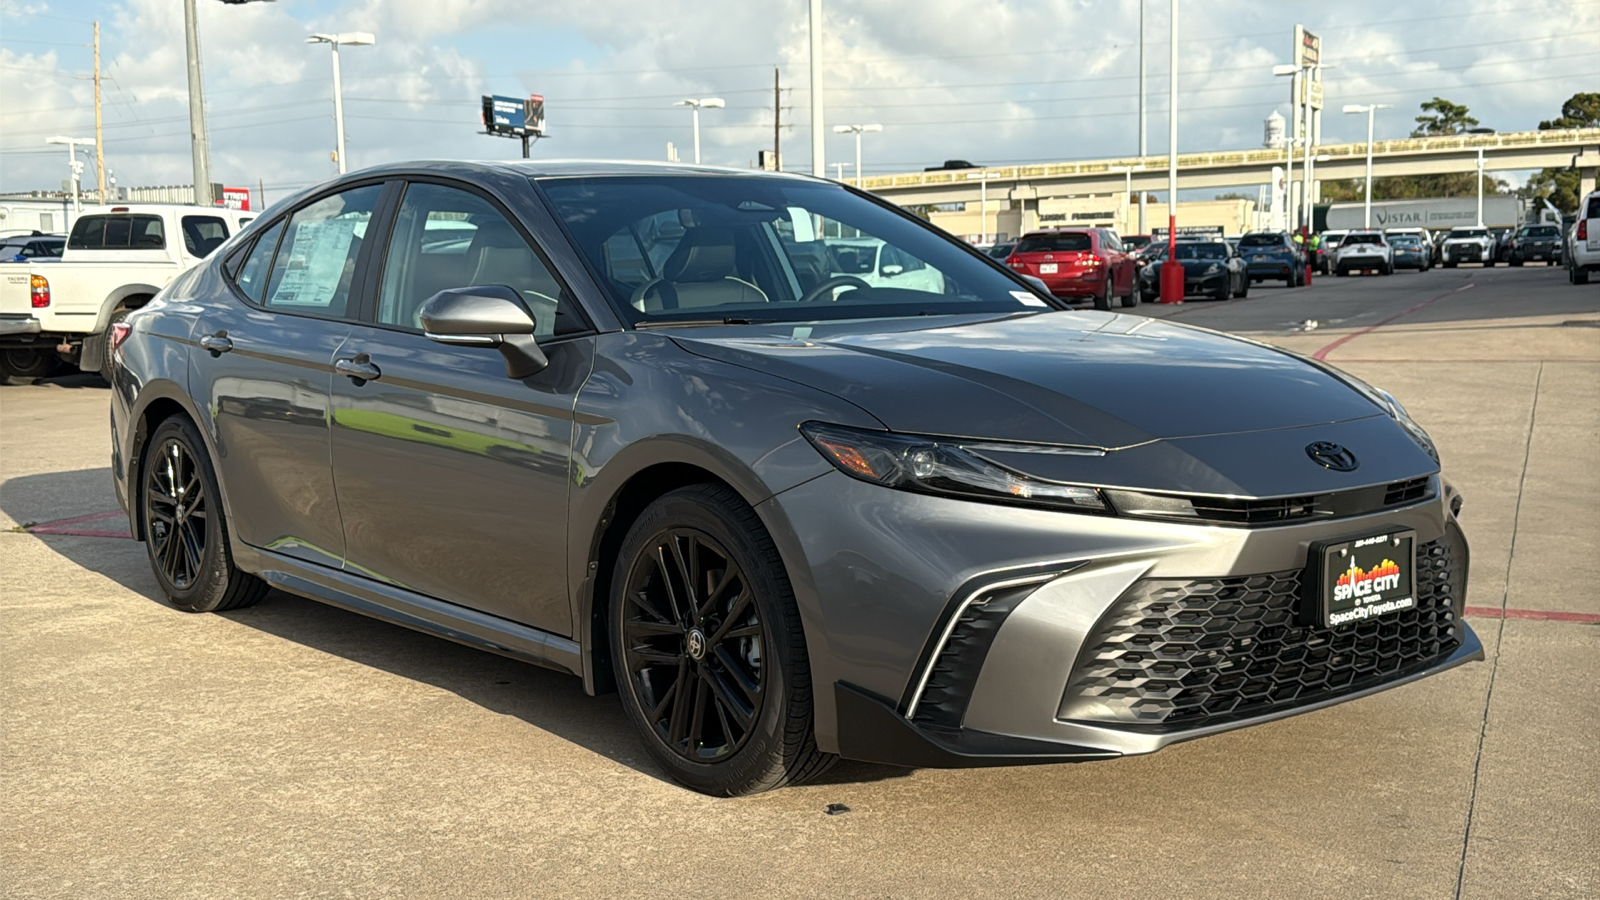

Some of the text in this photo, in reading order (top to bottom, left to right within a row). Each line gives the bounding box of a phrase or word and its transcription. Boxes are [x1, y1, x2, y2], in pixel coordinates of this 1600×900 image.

[1376, 208, 1421, 225] VISTAR
[1334, 573, 1400, 601] SPACE CITY
[1362, 594, 1382, 603] TOYOTA
[1329, 597, 1413, 625] SpaceCityToyota.com
